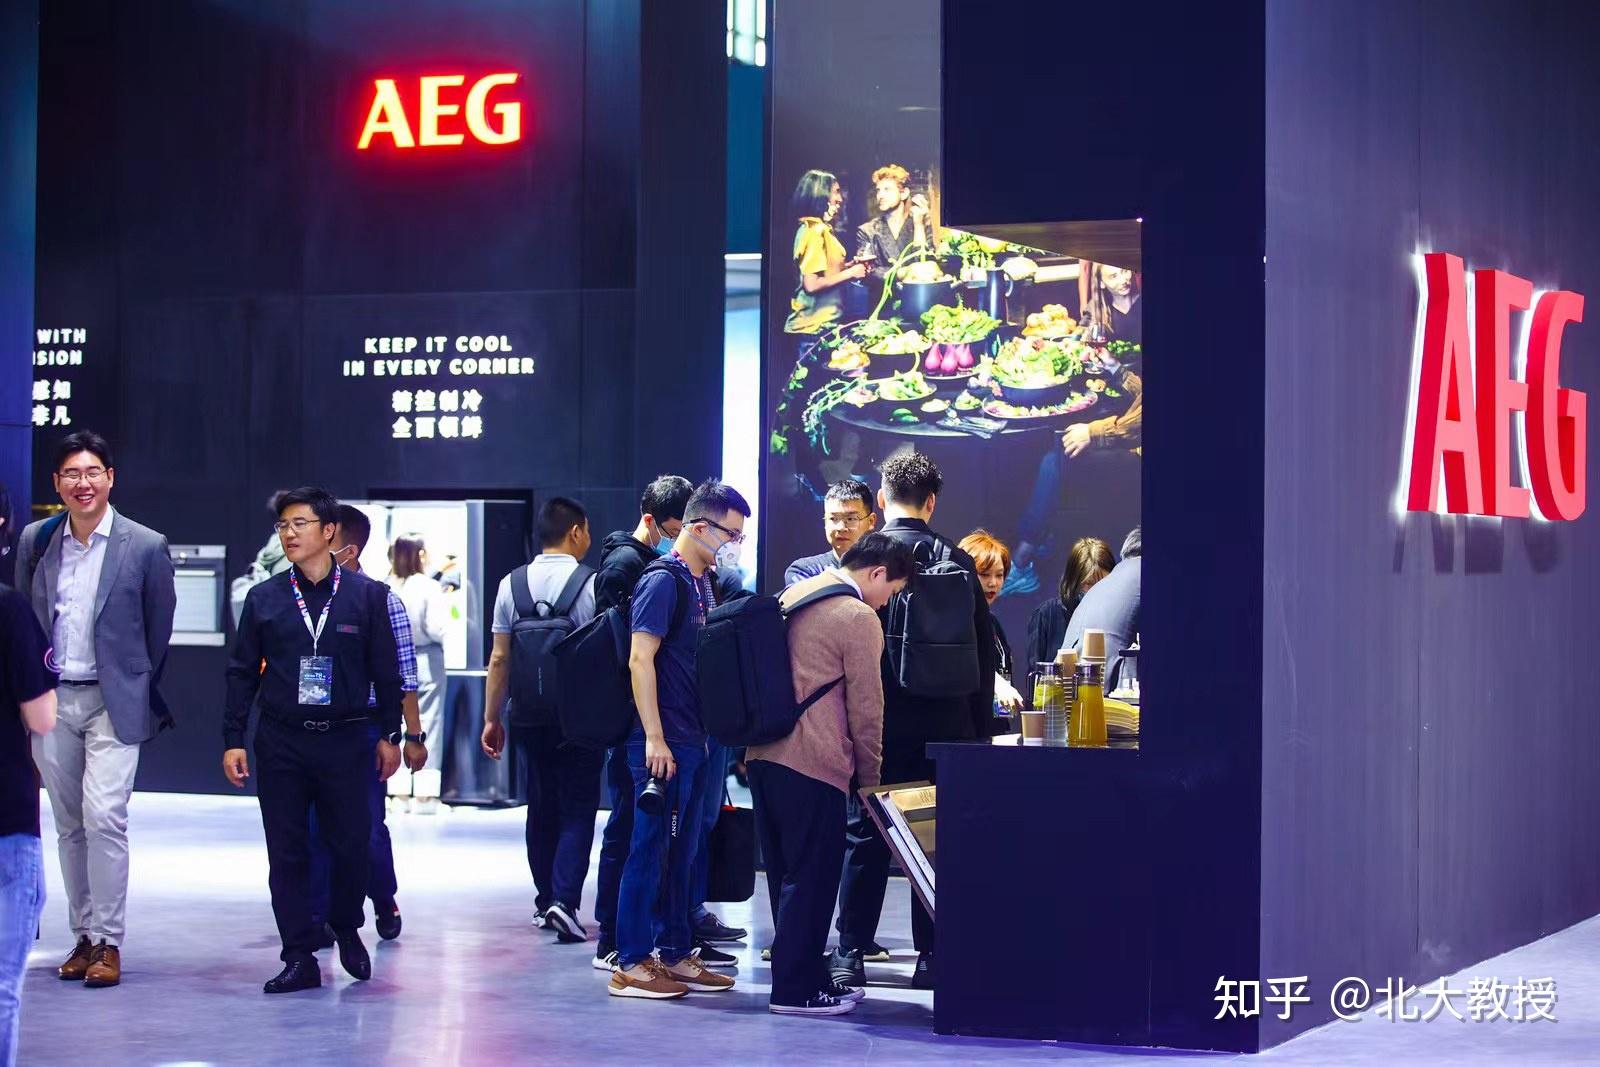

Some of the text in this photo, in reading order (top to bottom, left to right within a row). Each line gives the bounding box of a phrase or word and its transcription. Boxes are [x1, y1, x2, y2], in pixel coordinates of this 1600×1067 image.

[356, 72, 522, 150] AEG
[36, 327, 87, 345] WITH
[364, 335, 513, 354] KEEP IT COOL
[343, 357, 535, 377] IN EVERY CORNER
[1404, 252, 1588, 521] AEG
[671, 813, 679, 838] SONY
